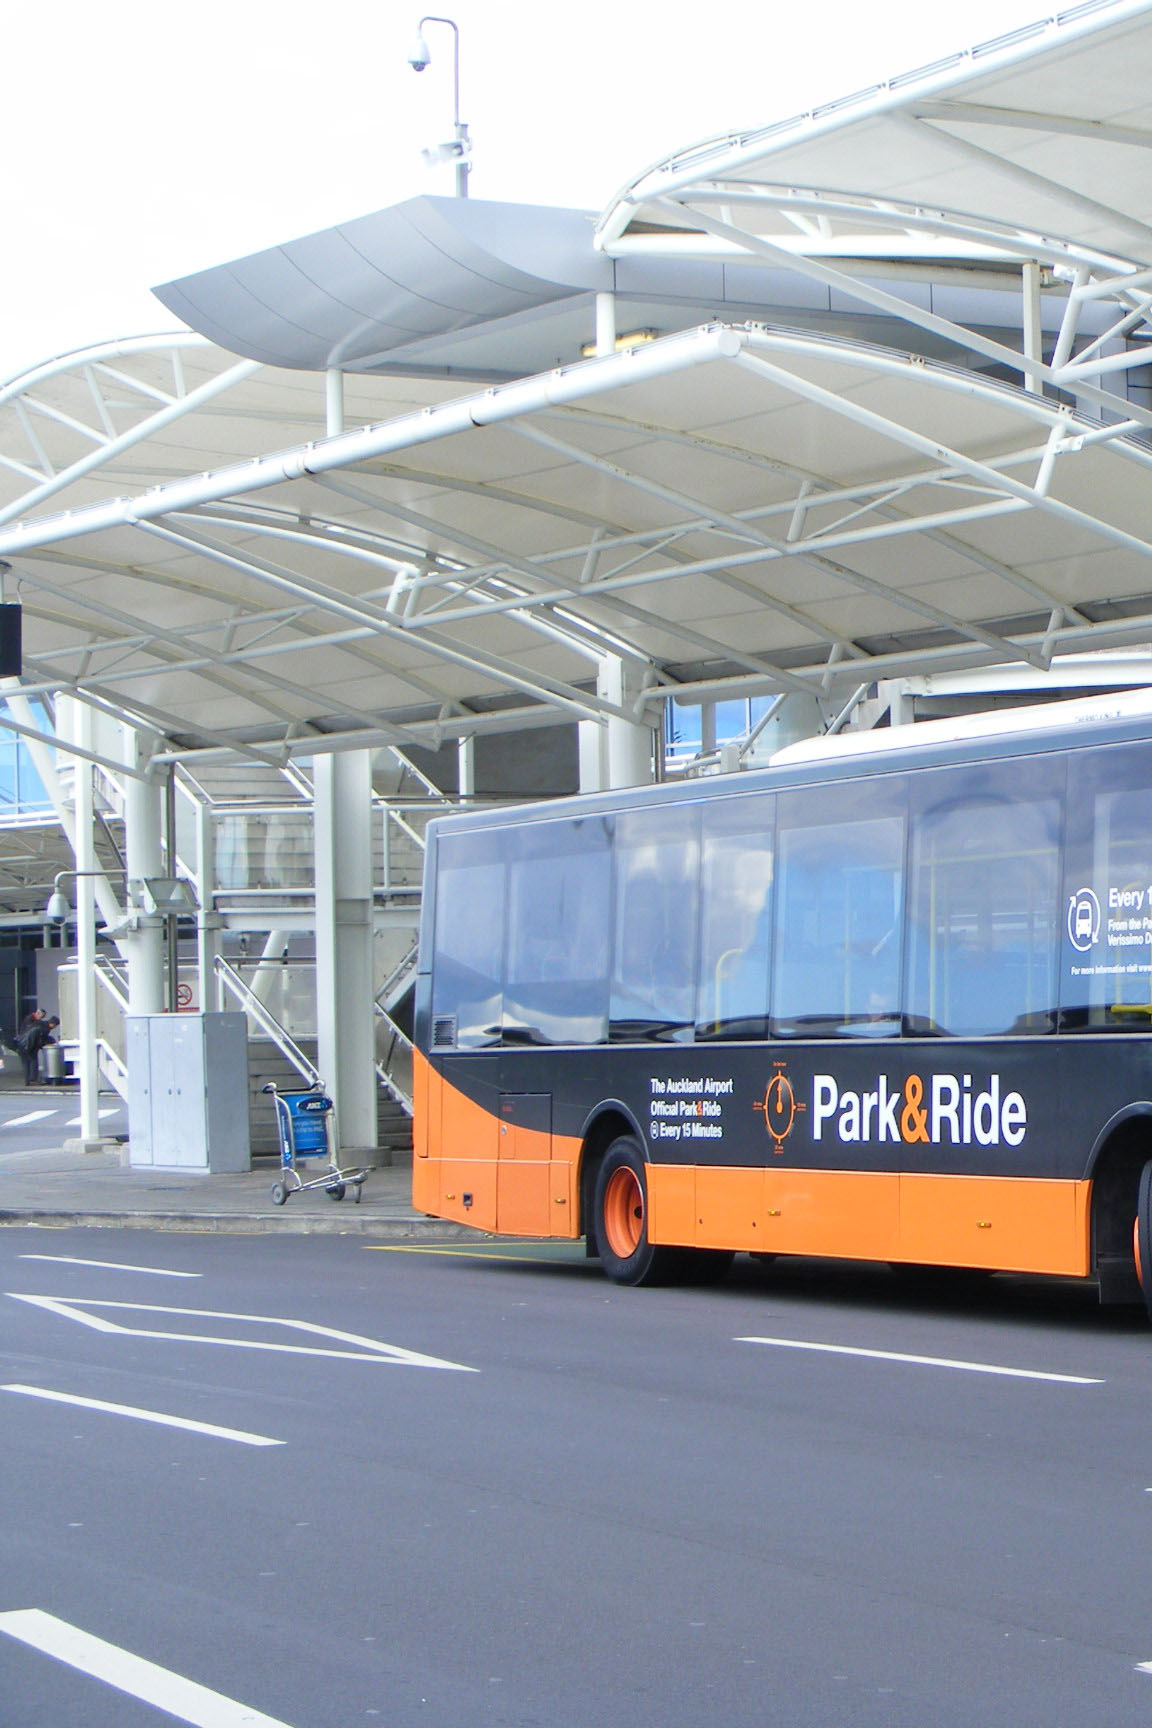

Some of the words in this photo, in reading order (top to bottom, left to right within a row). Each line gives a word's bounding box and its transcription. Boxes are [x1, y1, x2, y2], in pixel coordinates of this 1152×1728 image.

[1109, 887, 1144, 910] Every
[1107, 919, 1128, 931] From
[1129, 918, 1142, 930] the
[650, 1078, 666, 1093] The
[666, 1078, 704, 1094] Auckland
[704, 1078, 734, 1097] Airport
[650, 1100, 679, 1116] Official
[660, 1121, 681, 1140] Every
[682, 1122, 691, 1137] 15
[692, 1122, 723, 1138] Minutes
